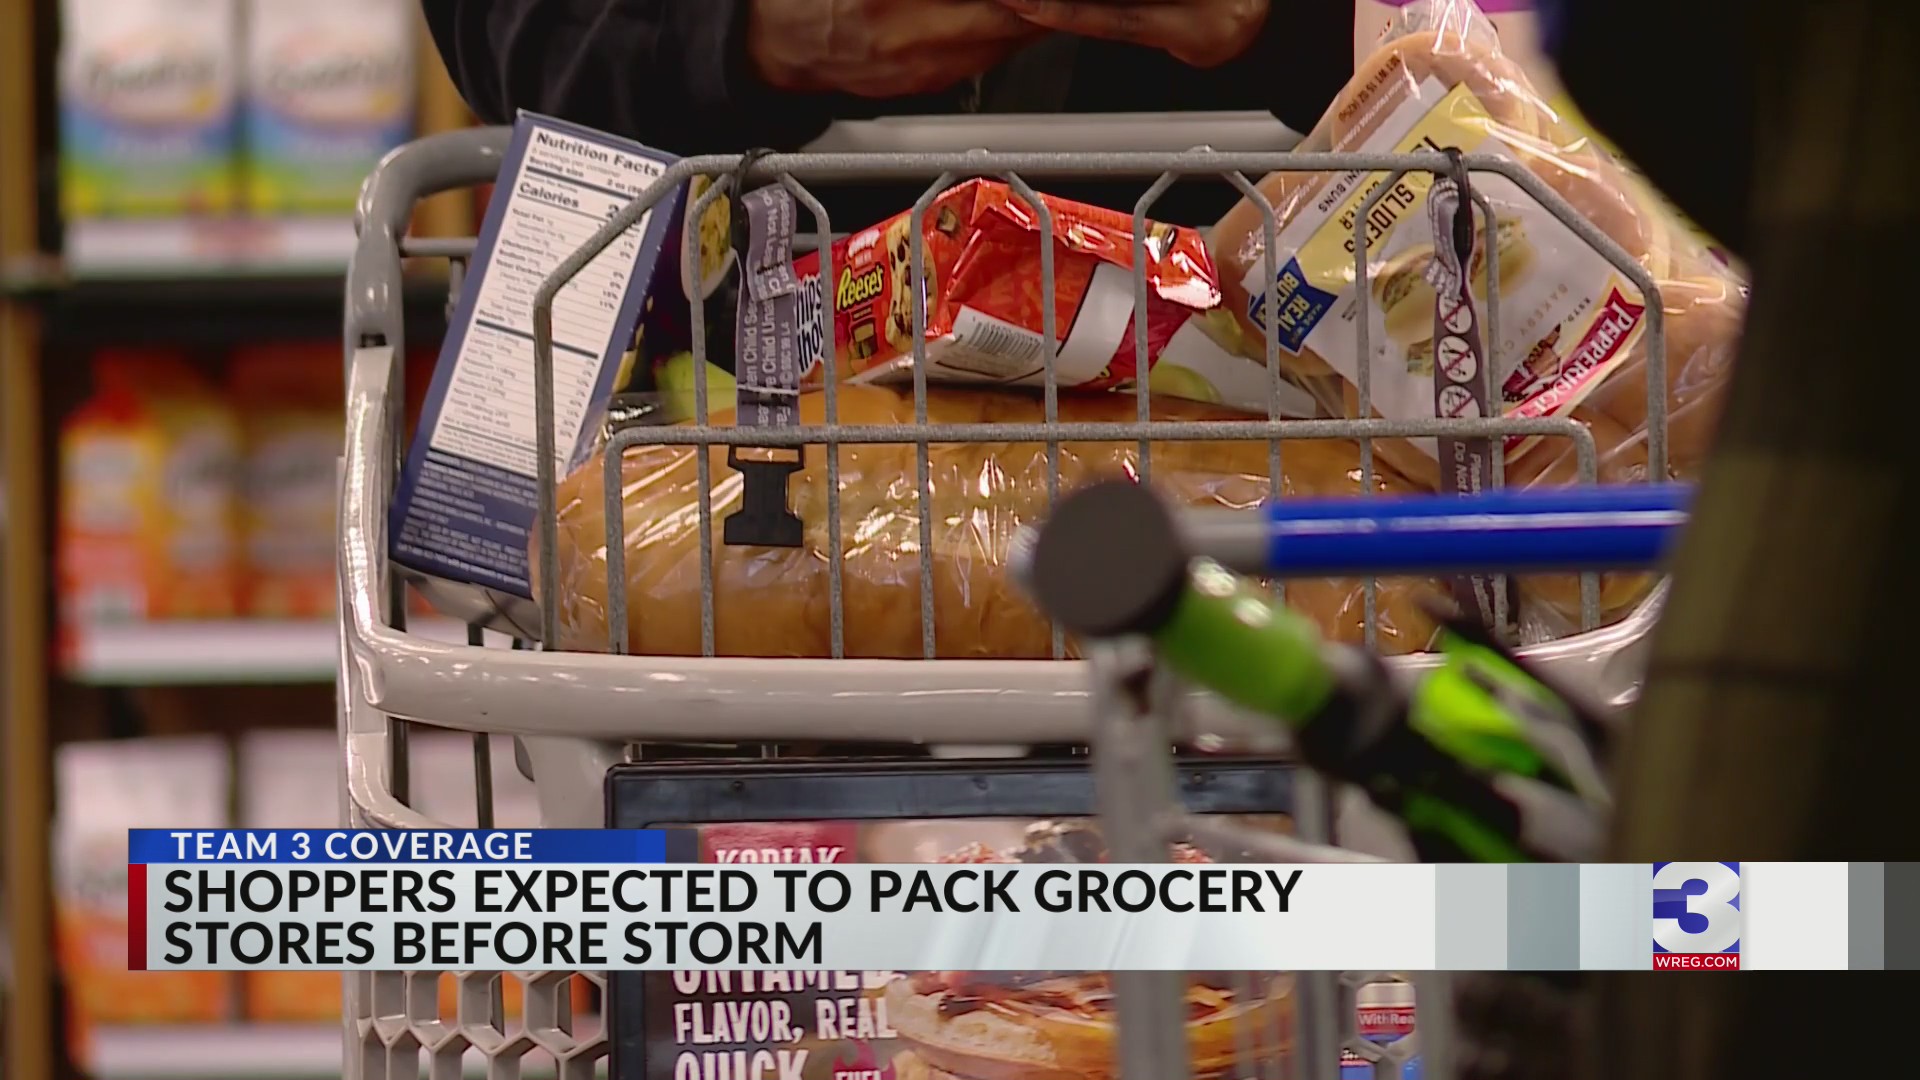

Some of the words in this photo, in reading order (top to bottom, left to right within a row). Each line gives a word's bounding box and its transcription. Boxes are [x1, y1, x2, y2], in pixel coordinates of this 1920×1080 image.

[536, 131, 609, 162] Nutrition
[613, 155, 660, 177] Facts
[519, 182, 580, 209] Calories
[1318, 184, 1347, 213] BUNS
[1519, 282, 1569, 339] BAKERY
[743, 327, 757, 363] Child
[762, 336, 776, 374] Child
[1534, 300, 1636, 416] PEPPERIDGE
[674, 1000, 805, 1044] FLAVOR,
[816, 997, 897, 1040] REAL
